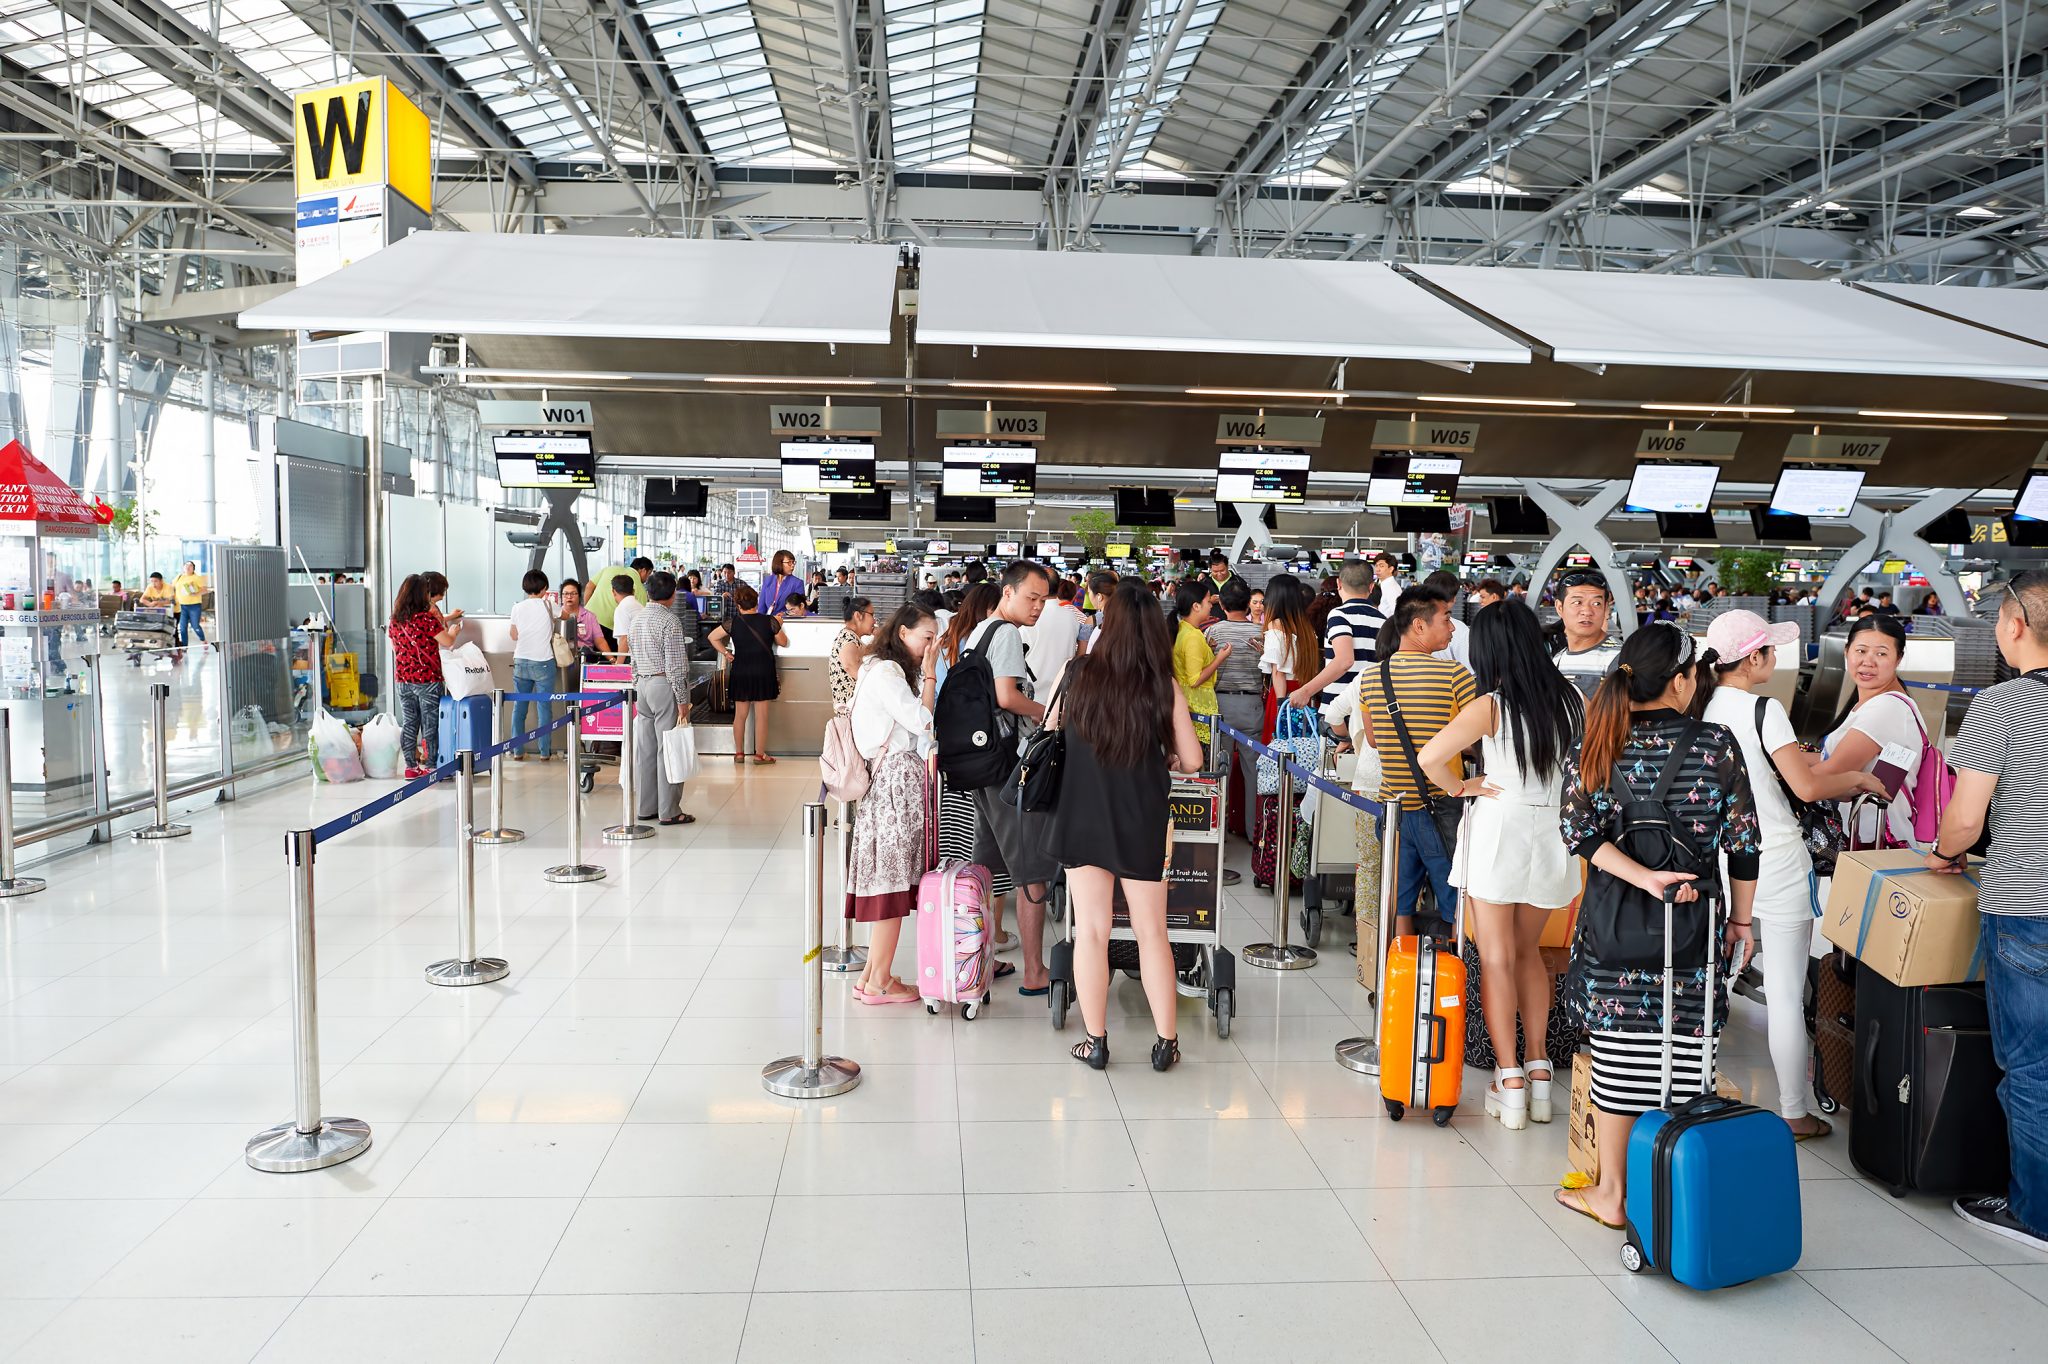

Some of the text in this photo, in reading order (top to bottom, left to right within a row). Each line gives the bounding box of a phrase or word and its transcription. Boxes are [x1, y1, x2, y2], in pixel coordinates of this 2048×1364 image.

[302, 90, 372, 180] W
[543, 408, 585, 423] W01
[778, 412, 820, 427] W02
[997, 418, 1038, 432] W03
[1226, 422, 1266, 437] W04
[1431, 430, 1470, 444] W05
[1647, 436, 1686, 451] W06
[1840, 442, 1880, 457] W07
[29, 484, 76, 496] IMPORTANT
[429, 772, 438, 783] AOT
[1308, 774, 1316, 784] AOT
[394, 791, 403, 803] AOT
[1342, 792, 1352, 802] AOT
[1170, 804, 1205, 815] AND
[351, 810, 362, 824] AOT
